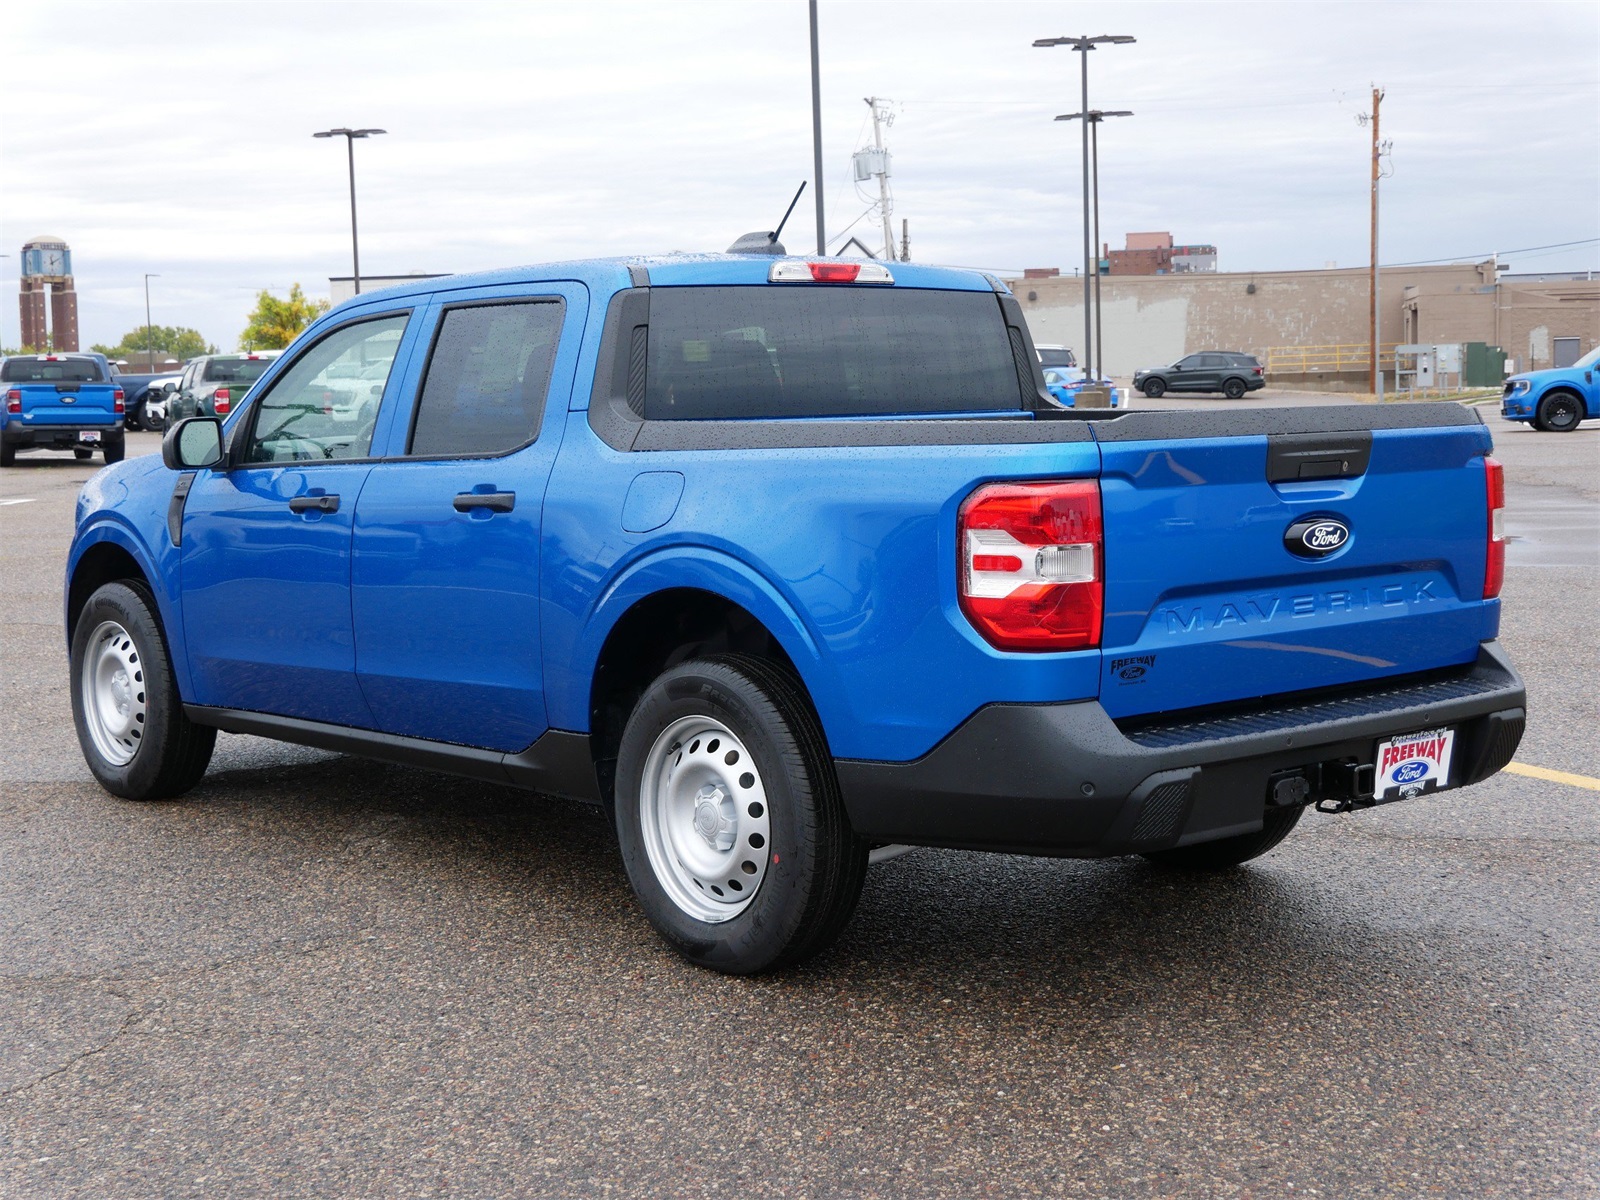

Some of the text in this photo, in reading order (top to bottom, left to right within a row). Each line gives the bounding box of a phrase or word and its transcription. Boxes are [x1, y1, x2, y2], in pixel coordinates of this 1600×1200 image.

[1311, 527, 1341, 547] Ford
[1165, 579, 1438, 635] MAVERICK
[1110, 655, 1157, 675] FREEWAY
[1123, 666, 1141, 678] Ford
[1380, 737, 1447, 779] FREEWAY
[1397, 764, 1423, 781] Ford
